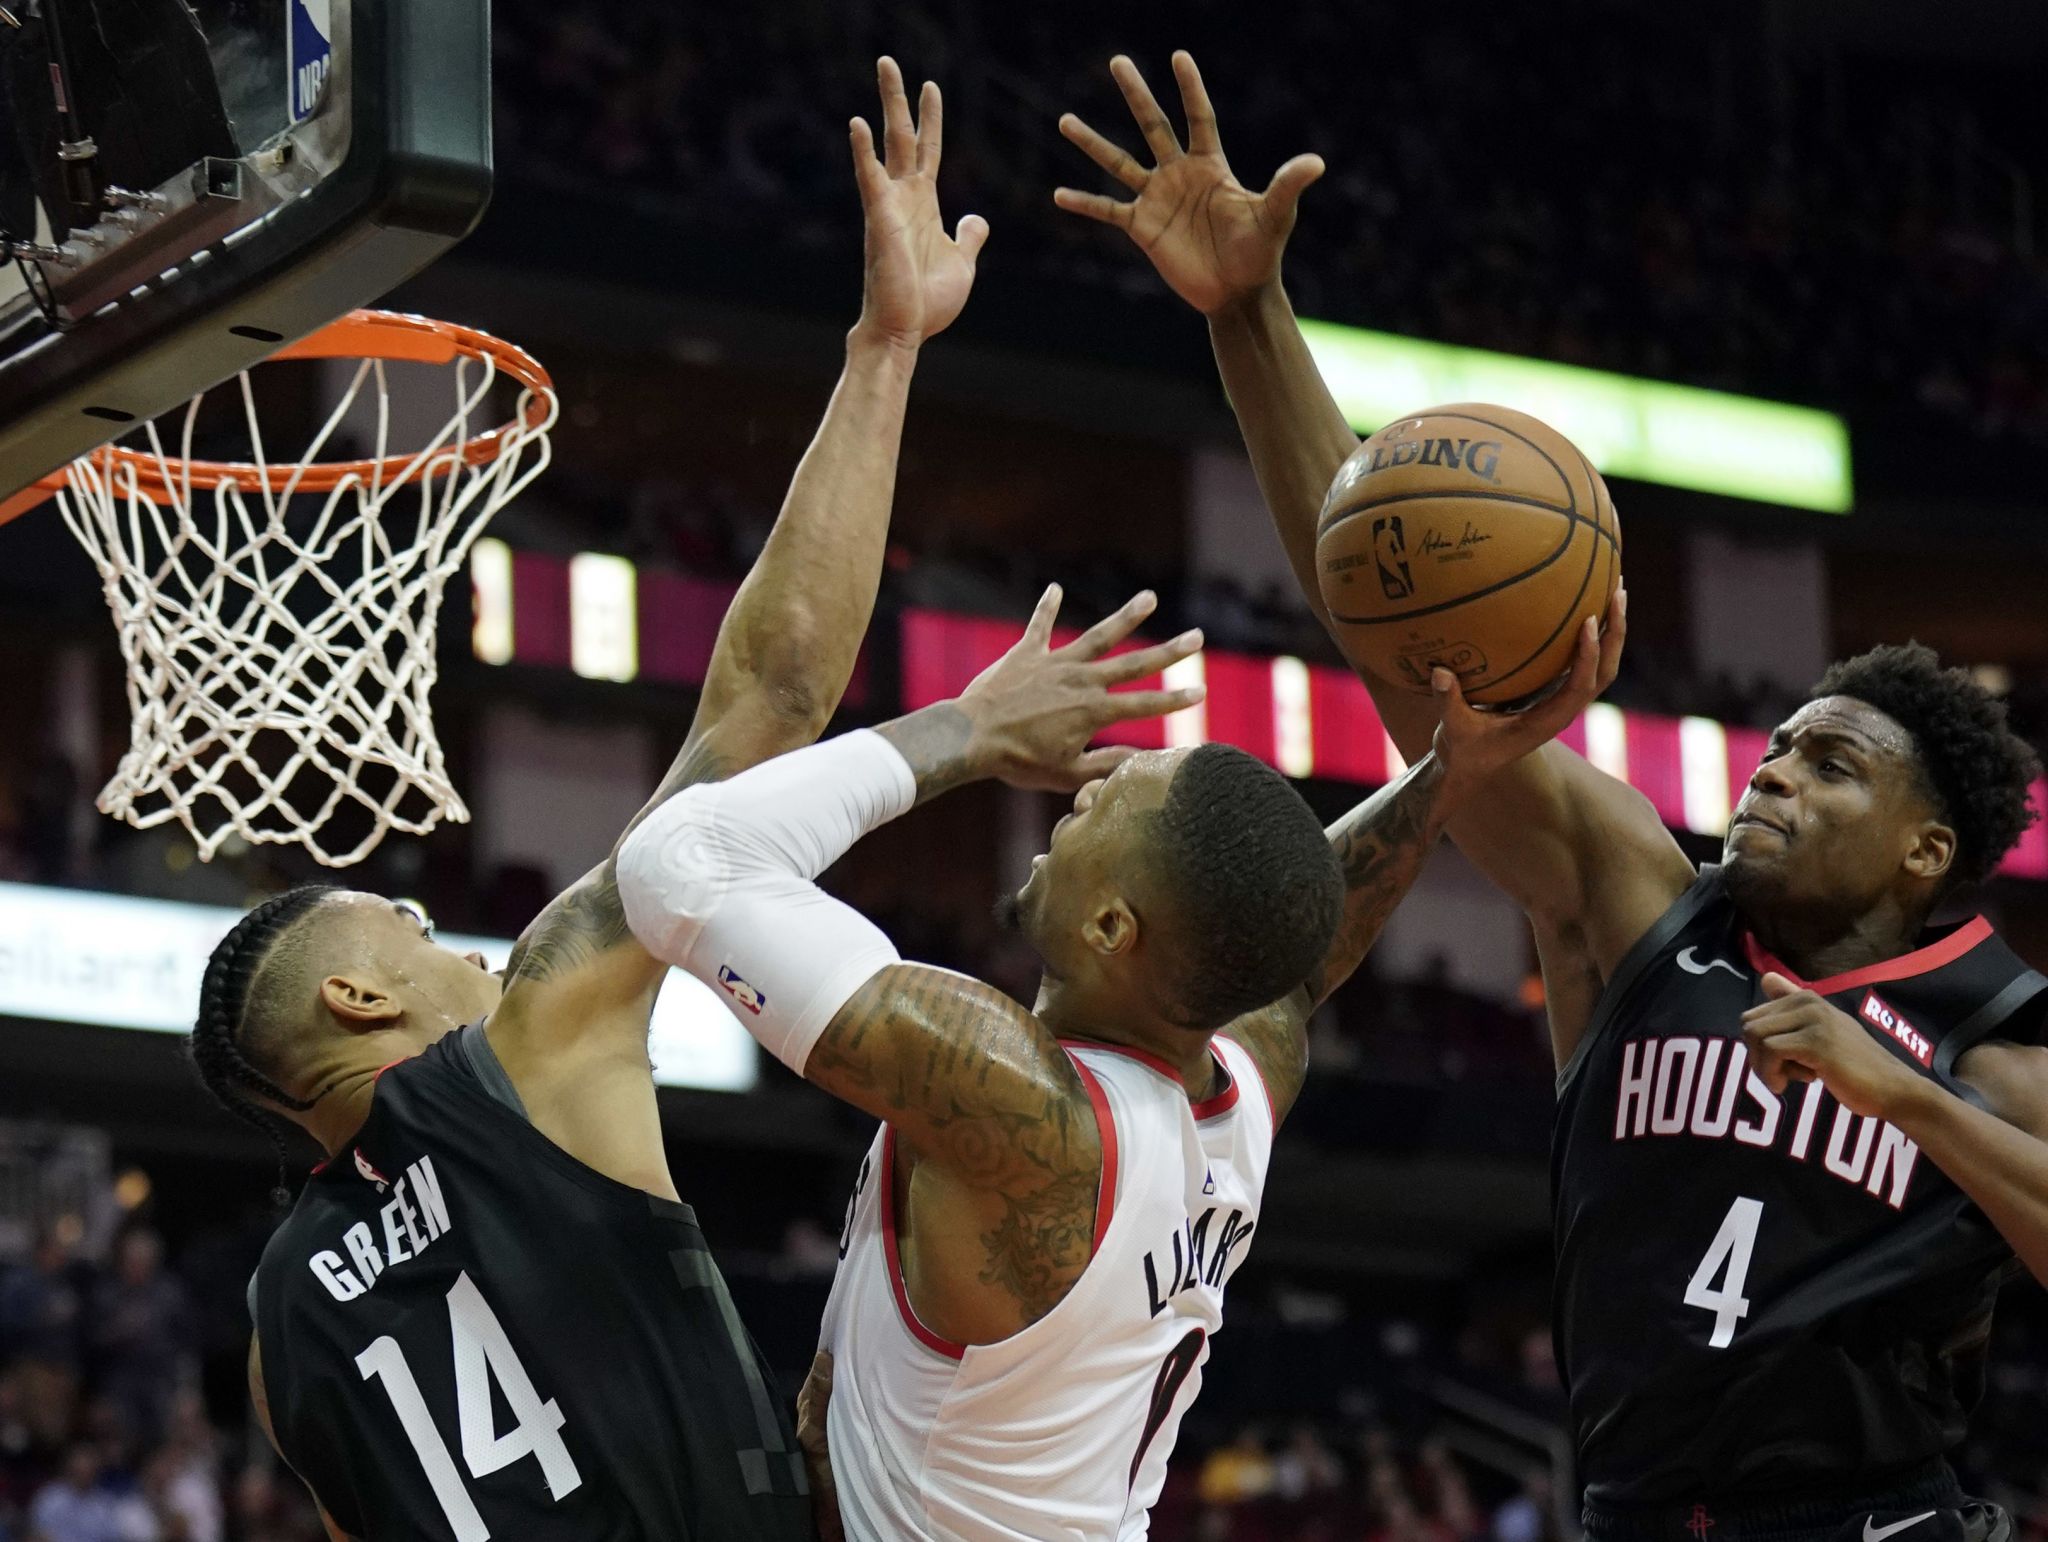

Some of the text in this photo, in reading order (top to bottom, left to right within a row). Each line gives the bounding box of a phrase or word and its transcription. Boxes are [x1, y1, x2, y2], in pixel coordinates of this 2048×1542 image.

[1328, 437, 1503, 500] LDING
[308, 1154, 452, 1302] GREEN
[1683, 1195, 1764, 1349] 4
[354, 1269, 583, 1542] 14
